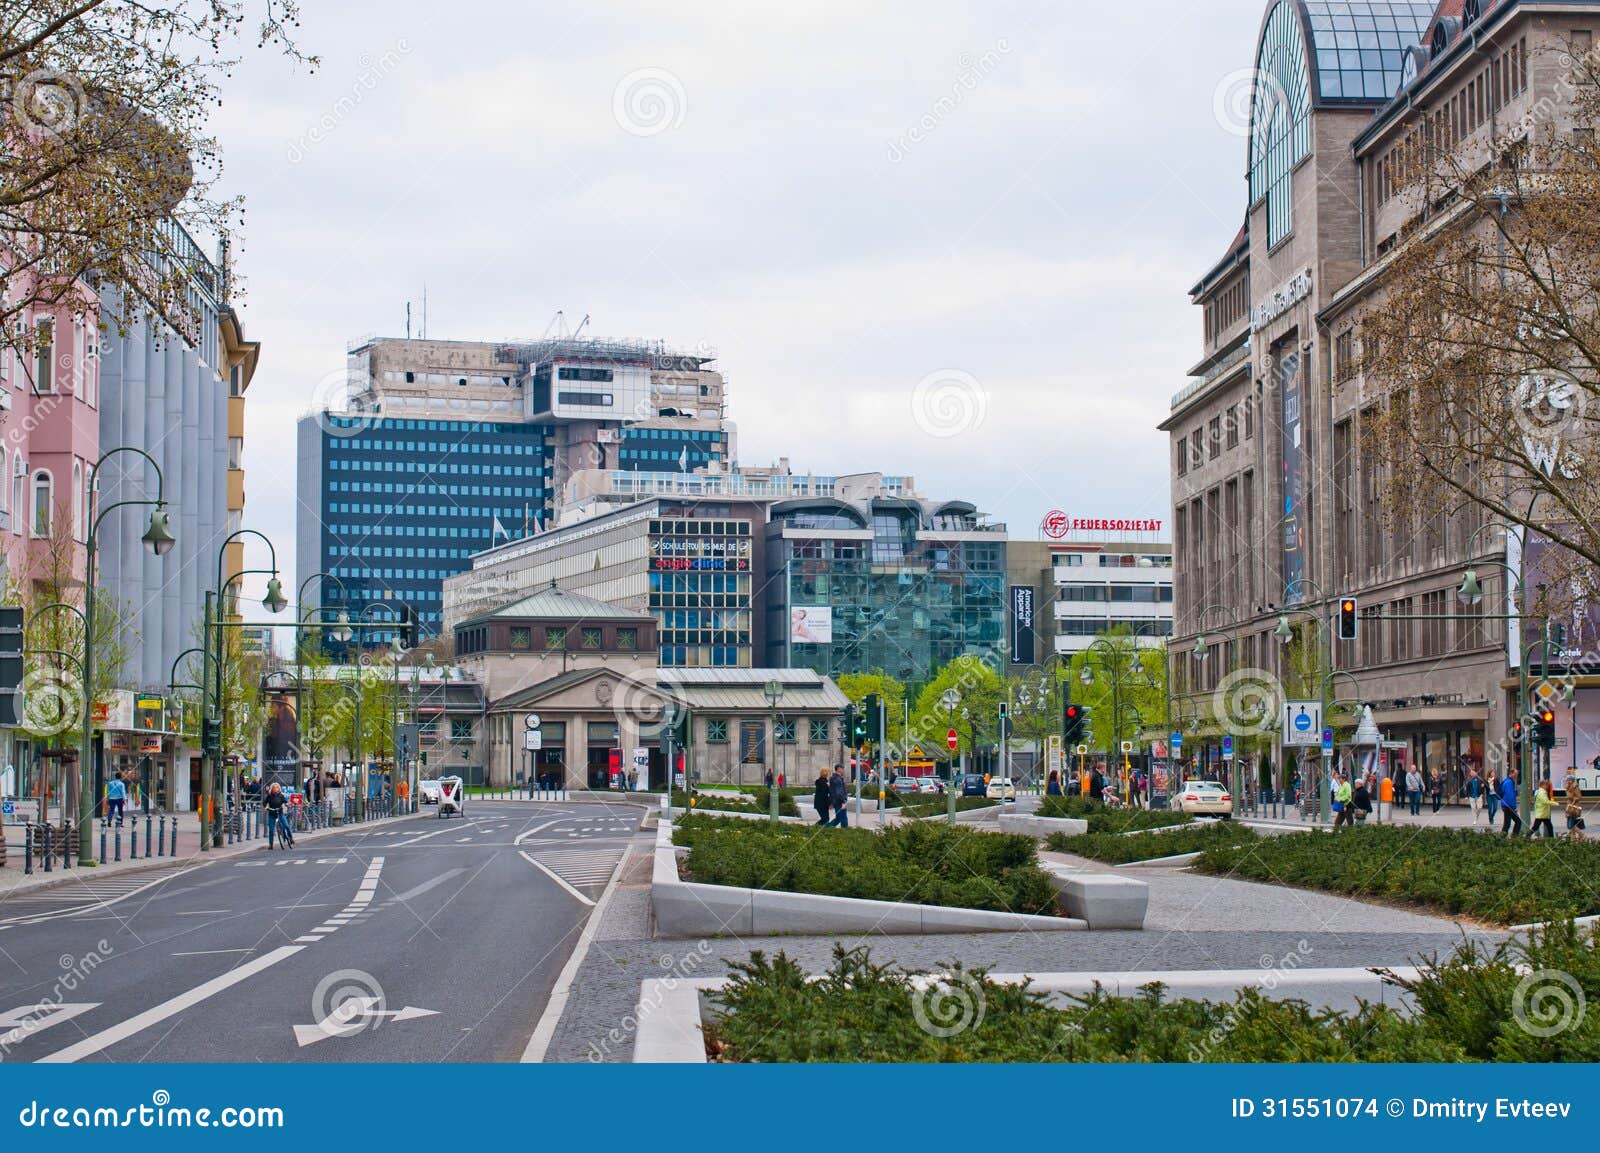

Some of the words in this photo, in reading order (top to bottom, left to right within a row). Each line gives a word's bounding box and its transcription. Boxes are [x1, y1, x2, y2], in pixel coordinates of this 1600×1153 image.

[1073, 518, 1162, 531] FEUERSOZIETÄT
[1017, 588, 1025, 620] Apparel
[1024, 588, 1032, 628] American
